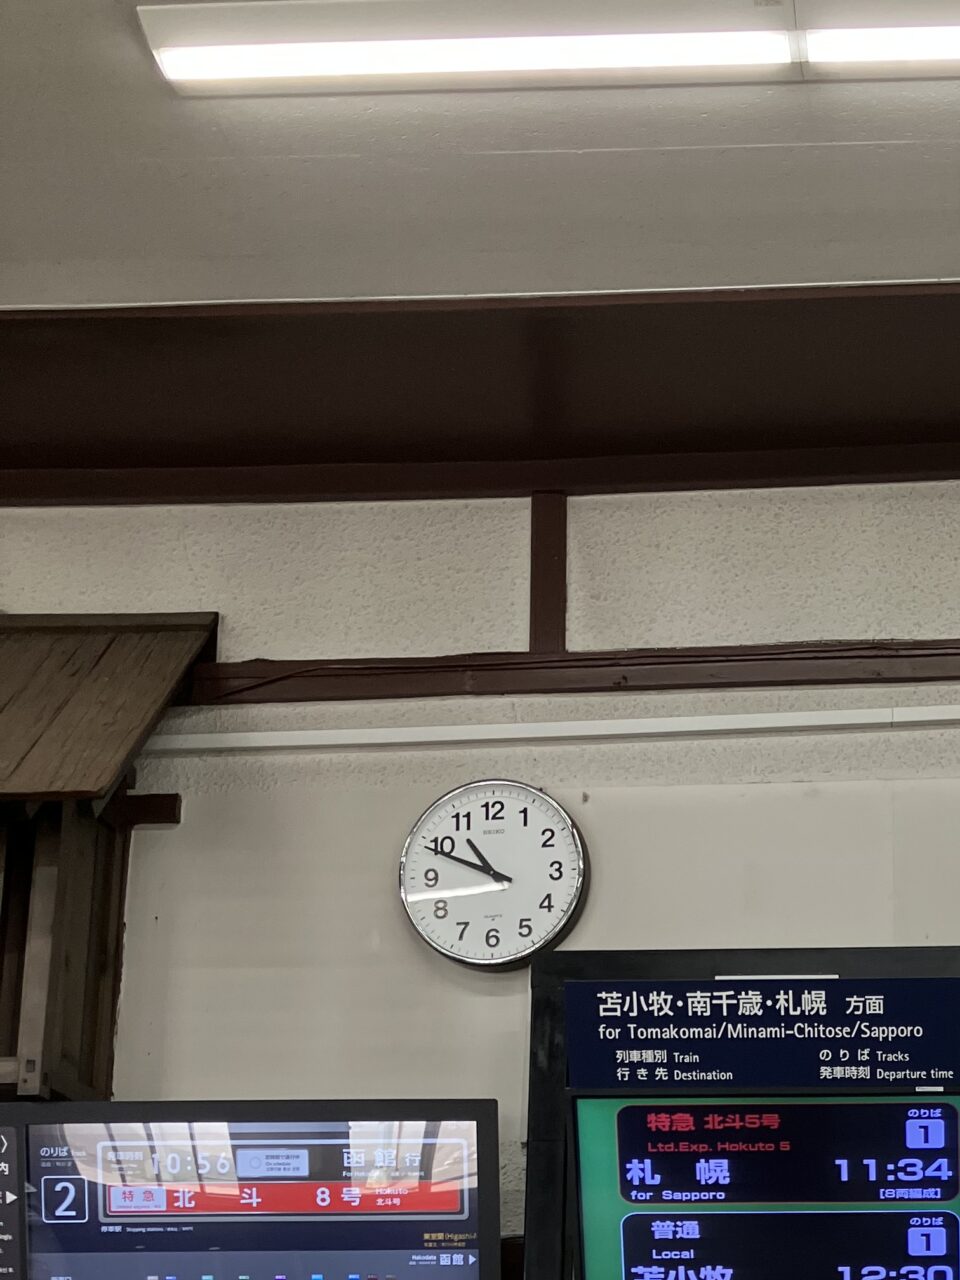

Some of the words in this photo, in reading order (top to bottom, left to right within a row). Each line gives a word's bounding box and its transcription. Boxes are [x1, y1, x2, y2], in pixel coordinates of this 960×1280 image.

[481, 801, 504, 820] 12
[519, 807, 527, 826] 1
[452, 812, 471, 831] 11
[431, 836, 455, 855] 10
[542, 829, 555, 847] 2
[424, 868, 439, 887] 9
[549, 861, 563, 880] 3
[434, 900, 448, 918] 8
[539, 894, 554, 912] 4
[456, 922, 469, 941] 7
[518, 918, 532, 937] 5
[486, 928, 500, 947] 6
[597, 991, 826, 1016] 苫小牧・南千歳・札幌
[845, 996, 884, 1015] 方面
[599, 1024, 621, 1039] for
[616, 1050, 667, 1063] 列車種別
[674, 1053, 699, 1062] Train
[819, 1049, 870, 1061] のりば
[877, 1051, 909, 1061] Tracks
[617, 1068, 668, 1080] 行き先
[674, 1070, 733, 1080] Destination
[820, 1067, 870, 1079] 発車時刻
[877, 1068, 926, 1081] Departure
[931, 1069, 953, 1079] time
[908, 1109, 941, 1117] のりば
[647, 1114, 695, 1131] 特急
[704, 1114, 780, 1131] 北斗5号
[918, 1127, 931, 1143] 1
[40, 1147, 68, 1156] のりば
[648, 1142, 713, 1154] Ltd.Exp.
[718, 1142, 775, 1151] Hokuto
[780, 1141, 790, 1150] 5
[152, 1152, 231, 1174] 10:56
[626, 1159, 730, 1184] 札幌
[835, 1159, 952, 1181] 11:34
[54, 1182, 76, 1216] 2
[121, 1190, 155, 1201] 特急
[631, 1191, 653, 1200] for
[662, 1190, 725, 1201] Sapporo
[651, 1221, 700, 1239] 普通
[910, 1217, 943, 1225] のりば
[920, 1234, 932, 1251] 1
[653, 1249, 694, 1259] Local
